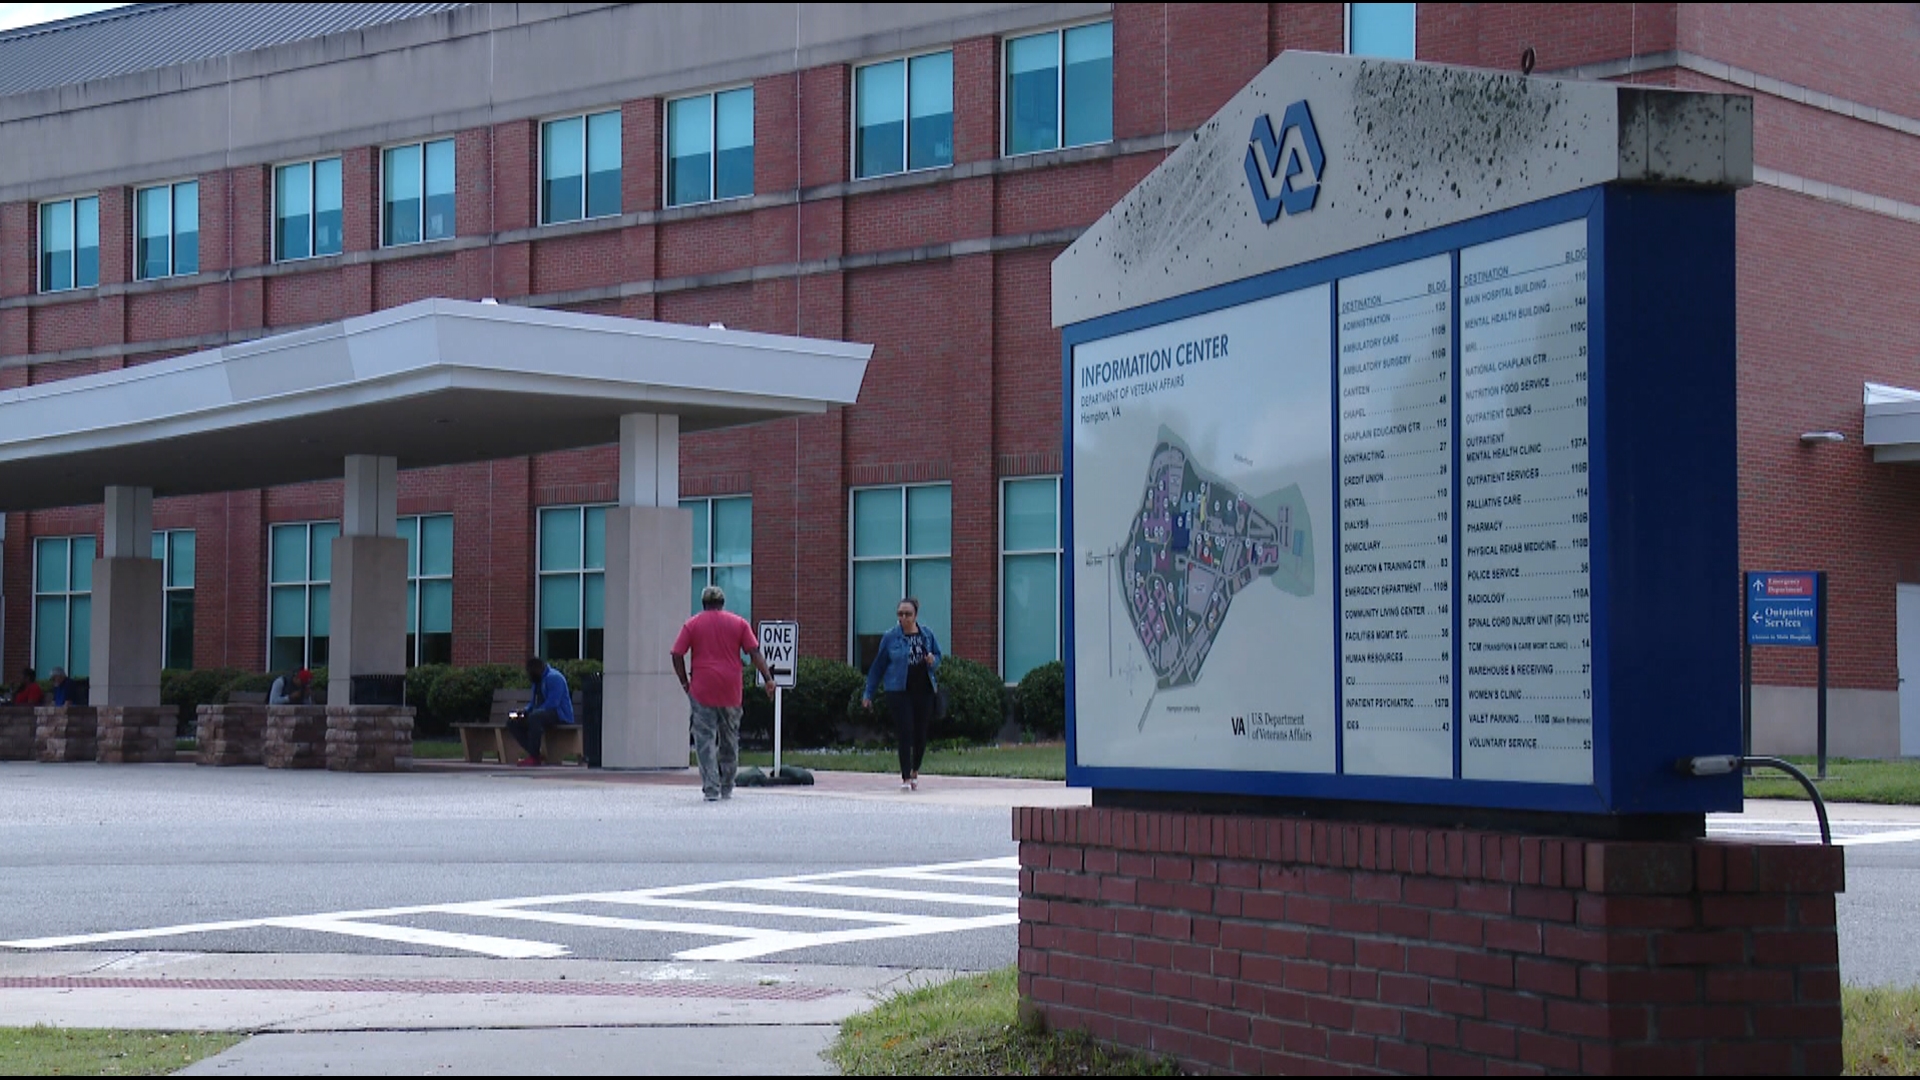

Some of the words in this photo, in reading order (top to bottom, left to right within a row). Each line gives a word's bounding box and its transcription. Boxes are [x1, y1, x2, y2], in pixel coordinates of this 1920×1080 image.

[1464, 266, 1508, 286] DESTINATION
[1566, 249, 1586, 263] BLDG
[1342, 296, 1381, 314] DESTINATION
[1428, 281, 1446, 293] BLDG
[1465, 296, 1479, 306] MAIN
[1482, 288, 1512, 301] HOSPITAL
[1515, 280, 1546, 295] BUILDING
[1343, 314, 1390, 330] ADMINISTRATION
[1465, 318, 1490, 329] MENTAL
[1491, 310, 1516, 324] HEALTH
[1519, 304, 1550, 319] BUILDING
[1343, 339, 1381, 353] AMBULATORY
[1383, 334, 1399, 345] CARE
[1432, 324, 1445, 335] 110B
[1465, 343, 1477, 352] MRI
[1571, 322, 1585, 332] 110C
[1082, 347, 1171, 388] INFORMATION
[1176, 334, 1228, 367] CENTER
[1343, 361, 1381, 375] AMBULATORY
[1383, 355, 1411, 368] SURGERY
[1466, 364, 1496, 376] NATIONAL
[1498, 356, 1531, 370] CHAPLAIN
[1533, 354, 1546, 364] CTR
[1081, 388, 1118, 407] DEPARTMENT
[1120, 387, 1128, 399] OF
[1131, 382, 1157, 397] VETERAN
[1159, 374, 1184, 390] AFFAIRS
[1344, 386, 1370, 398] CANTEEN
[1440, 372, 1446, 380] 17
[1466, 386, 1499, 400] NUTRITION
[1501, 383, 1519, 394] FOOD
[1521, 378, 1549, 391] SERVICE
[1081, 409, 1110, 424] Hampton,
[1112, 406, 1120, 417] VA
[1344, 409, 1366, 419] CHAPEL
[1466, 410, 1504, 424] OUTPATIENT
[1506, 404, 1531, 417] CLINICS
[1576, 396, 1586, 407] 110
[1344, 430, 1372, 442] CHAPLAIN
[1374, 425, 1406, 437] EDUCATION
[1408, 422, 1420, 432] CTR
[1437, 418, 1446, 427] 115
[1466, 433, 1504, 447] OUTPATIENT
[1344, 450, 1384, 464] CONTRACTING
[1440, 442, 1446, 451] 27
[1467, 450, 1491, 462] MENTAL
[1493, 446, 1517, 459] HEALTH
[1520, 444, 1541, 455] CLINIC
[1571, 437, 1587, 449] 137A
[1344, 475, 1364, 486] CREDIT
[1366, 473, 1383, 483] UNION
[1467, 472, 1505, 486] OUTPATIENT
[1507, 468, 1539, 481] SERVICES
[1572, 462, 1587, 473] 110B
[1345, 498, 1365, 508] DENTAL
[1438, 488, 1447, 497] 110
[1467, 497, 1501, 509] PALLIATIVE
[1504, 495, 1521, 505] CARE
[1345, 519, 1368, 530] DIALYSIS
[1438, 511, 1447, 521] 110
[1468, 521, 1502, 533] PHARMACY
[1572, 512, 1587, 523] 110B
[1345, 541, 1380, 552] DOMICILIARY
[1468, 545, 1498, 557] PHYSICAL
[1500, 543, 1522, 554] REHAB
[1524, 541, 1556, 552] MEDICINE
[1345, 564, 1376, 575] EDUCATION
[1379, 562, 1382, 572] &
[1384, 560, 1411, 571] TRAINING
[1413, 559, 1425, 569] CTR
[1468, 570, 1490, 581] POLICE
[1492, 567, 1519, 579] SERVICE
[1345, 586, 1380, 597] EMERGENCY
[1382, 582, 1421, 595] DEPARTMENT
[1434, 582, 1447, 591] 110B
[1468, 593, 1504, 604] RADIOLOGY
[1573, 588, 1589, 598] 110A
[1345, 608, 1378, 619] COMMUNITY
[1380, 607, 1399, 617] LIVING
[1401, 606, 1425, 615] CENTER
[1468, 617, 1490, 628] SPINAL
[1492, 616, 1510, 627] CORD
[1512, 615, 1535, 625] INJURY
[1537, 615, 1552, 625] UNIT
[1555, 614, 1570, 626] (SCI)
[1573, 613, 1589, 624] 137C
[1765, 607, 1813, 618] Outpatient
[1765, 619, 1801, 627] Services
[764, 628, 791, 643] ONE
[1345, 631, 1374, 641] FACILITIES
[1469, 642, 1481, 651] TCM
[1582, 639, 1589, 648] 14
[764, 646, 792, 661] WAY
[1346, 654, 1365, 663] HUMAN
[1367, 652, 1402, 663] RESOURCES
[1468, 665, 1509, 675] WAREHOUSE
[1511, 665, 1515, 675] &
[1517, 664, 1553, 675] RECEIVING
[1582, 664, 1590, 673] 27
[1346, 677, 1355, 685] ICU
[1439, 675, 1448, 684] 110
[1469, 690, 1498, 699] WOMEN'S
[1501, 690, 1521, 699] CLINIC
[1583, 689, 1590, 699] 13
[1346, 699, 1374, 707] INPATIENT
[1376, 698, 1414, 707] PSYCHIATRIC
[1232, 717, 1245, 735] VA
[1252, 713, 1263, 725] U.S.
[1265, 714, 1304, 727] Department
[1469, 714, 1488, 723] VALET
[1490, 714, 1518, 723] PARKING
[1252, 729, 1259, 740] of
[1259, 729, 1287, 741] Veterans
[1289, 729, 1312, 741] Affairs
[1469, 738, 1506, 747] VOLUNTARY
[1509, 738, 1536, 749] SERVICE
